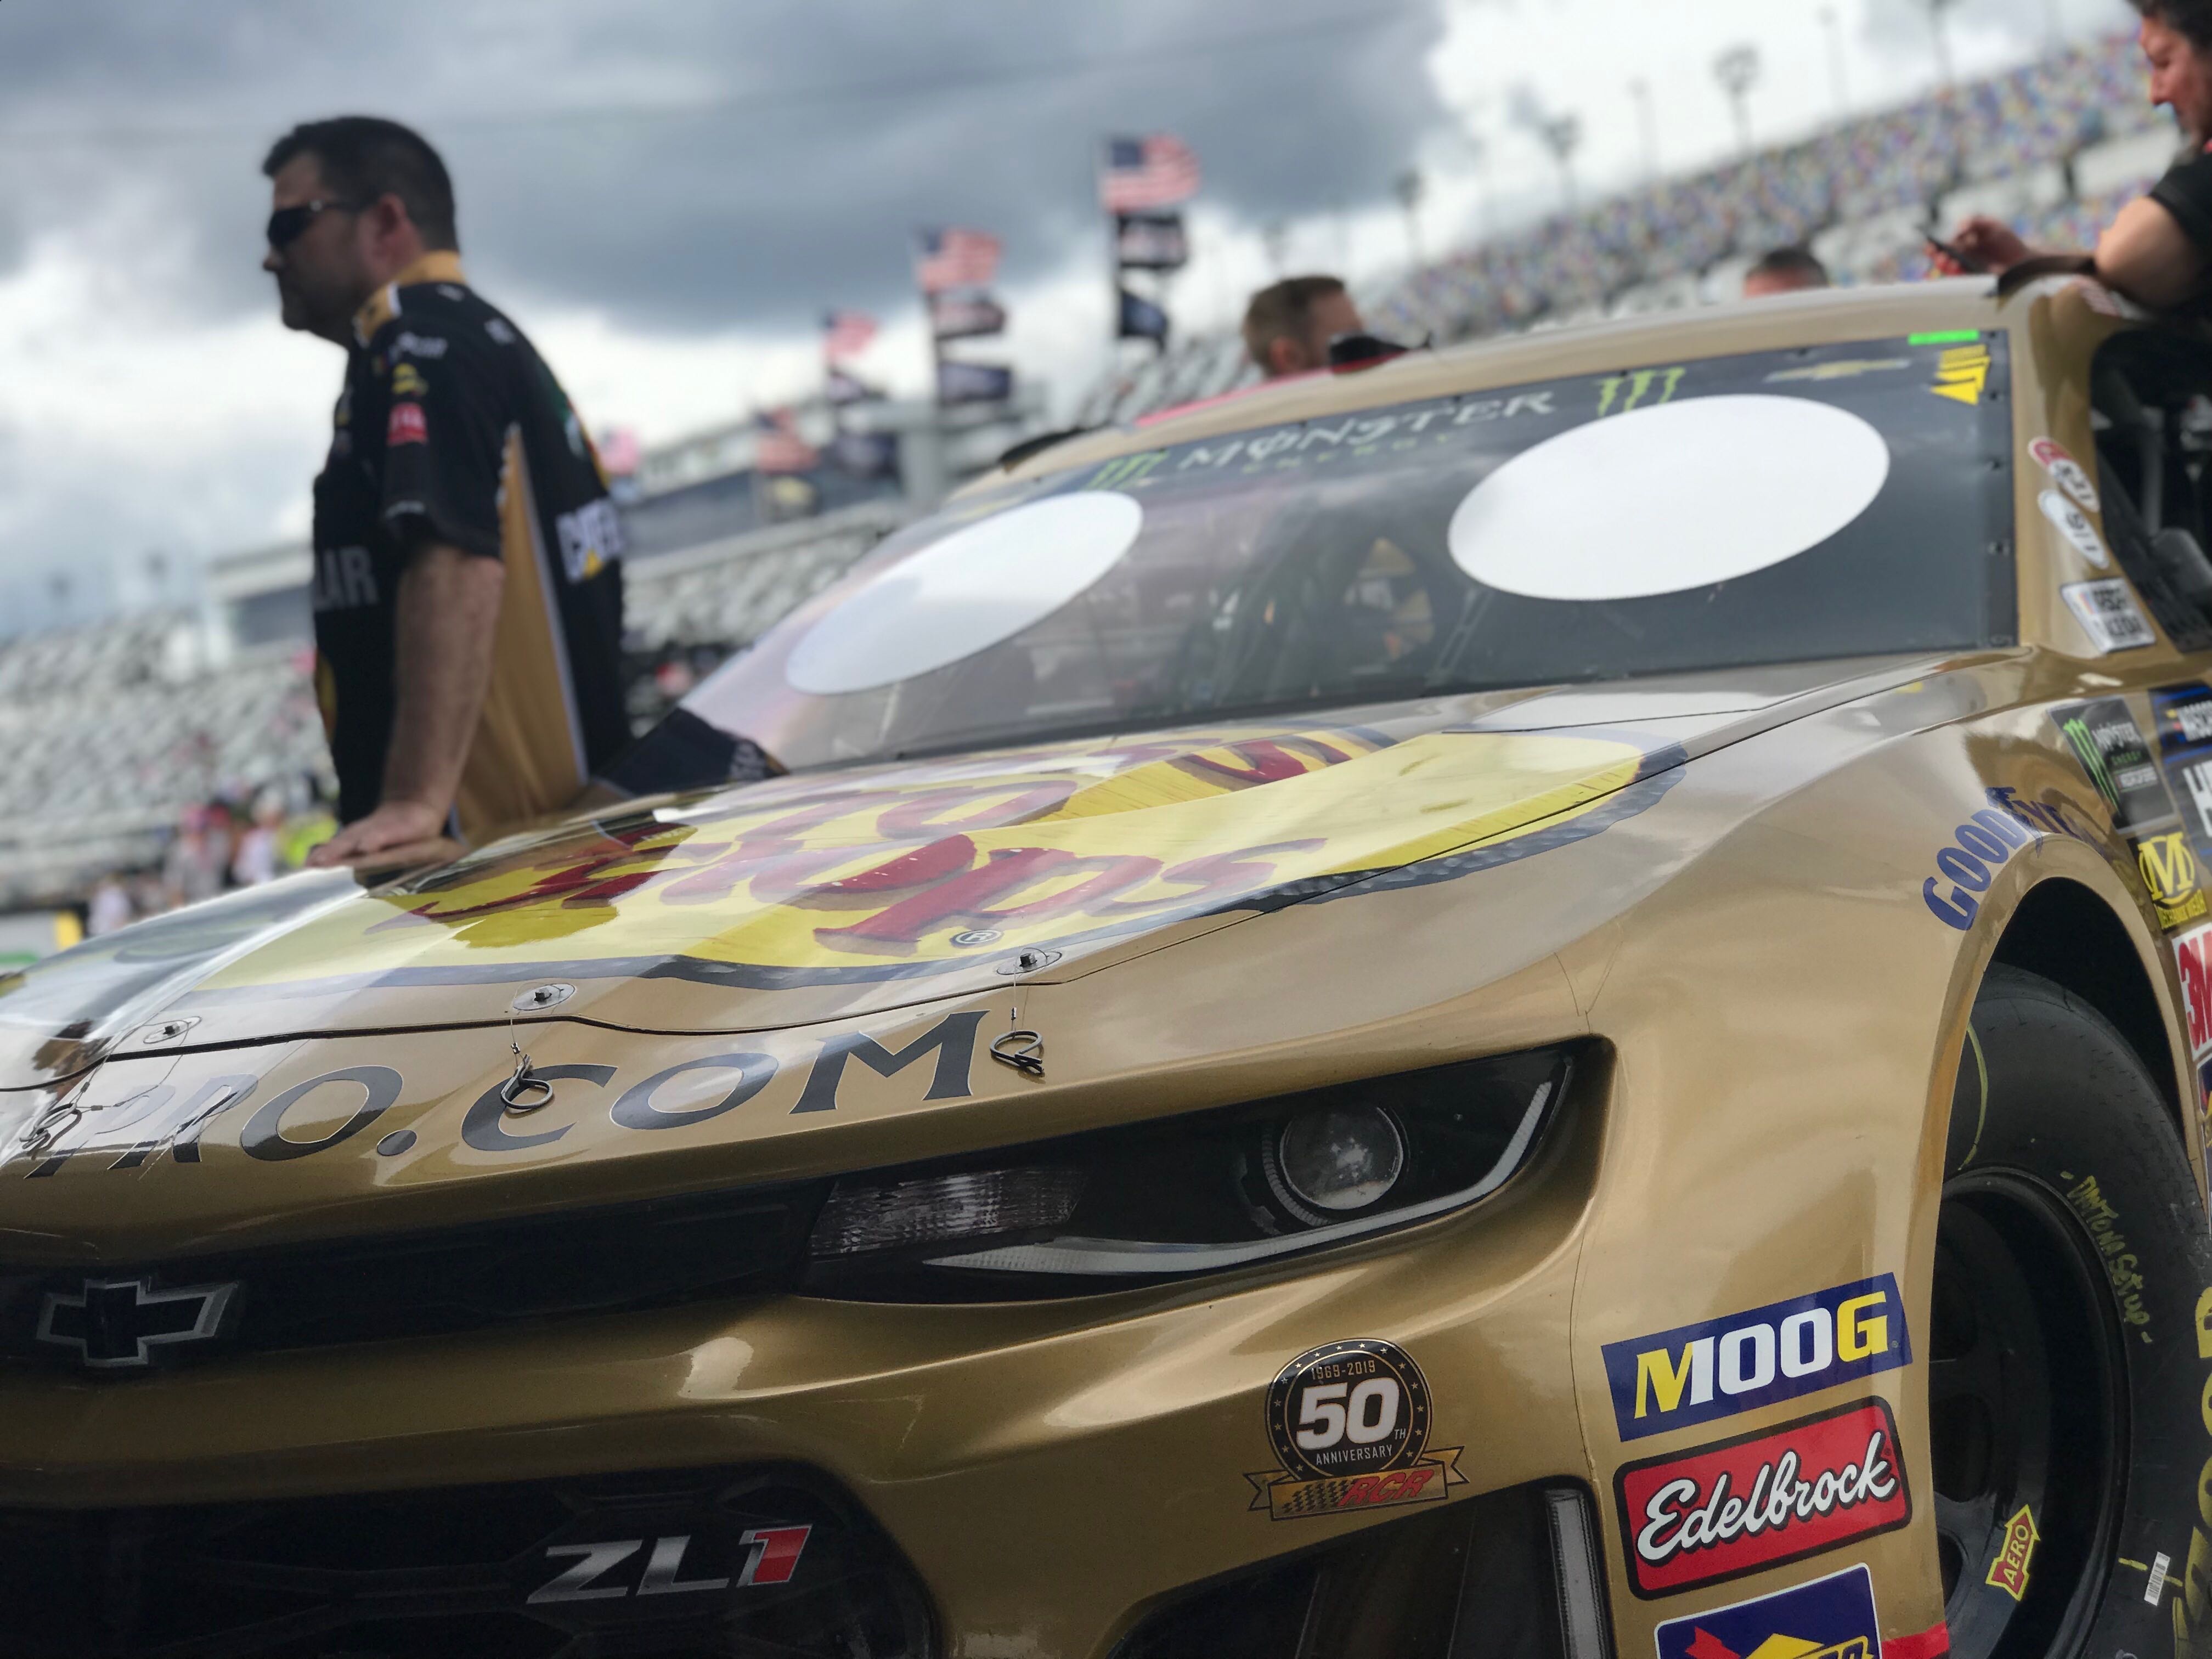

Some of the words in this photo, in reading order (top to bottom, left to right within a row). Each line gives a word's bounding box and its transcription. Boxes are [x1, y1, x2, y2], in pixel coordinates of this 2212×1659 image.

[1178, 390, 1557, 470] MONSTER
[1311, 1359, 1376, 1380] 1969-2019
[1634, 1290, 1888, 1419] MOOG
[1316, 1444, 1392, 1465] ANNIVERSARY
[1337, 1469, 1435, 1508] RCR
[1637, 1431, 1896, 1561] Edelbrock
[526, 1523, 813, 1605] ZL1
[2002, 1524, 2029, 1586] AERO
